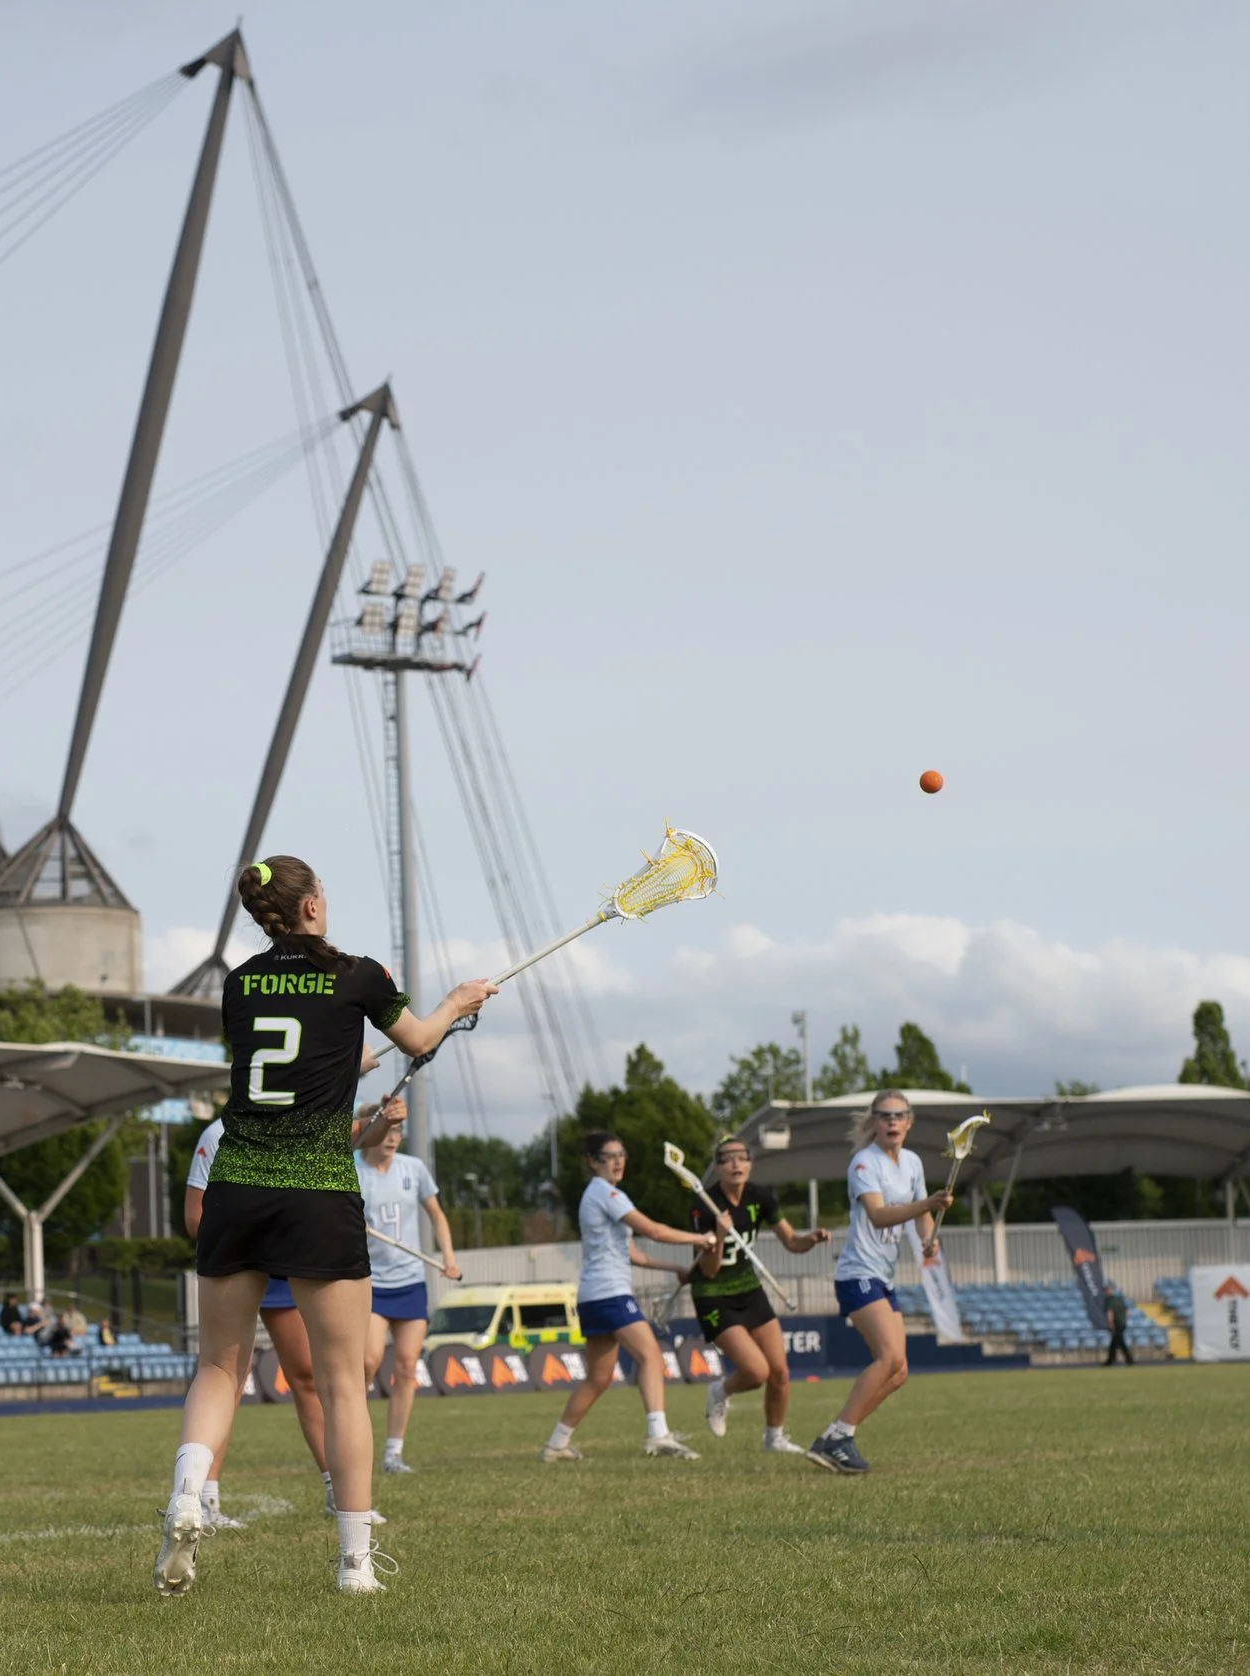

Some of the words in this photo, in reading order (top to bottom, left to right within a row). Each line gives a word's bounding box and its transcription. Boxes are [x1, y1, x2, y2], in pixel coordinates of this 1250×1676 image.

[239, 973, 337, 996] FORGE
[248, 1017, 302, 1105] 2
[379, 1202, 402, 1241] 4
[783, 1331, 821, 1353] TER
